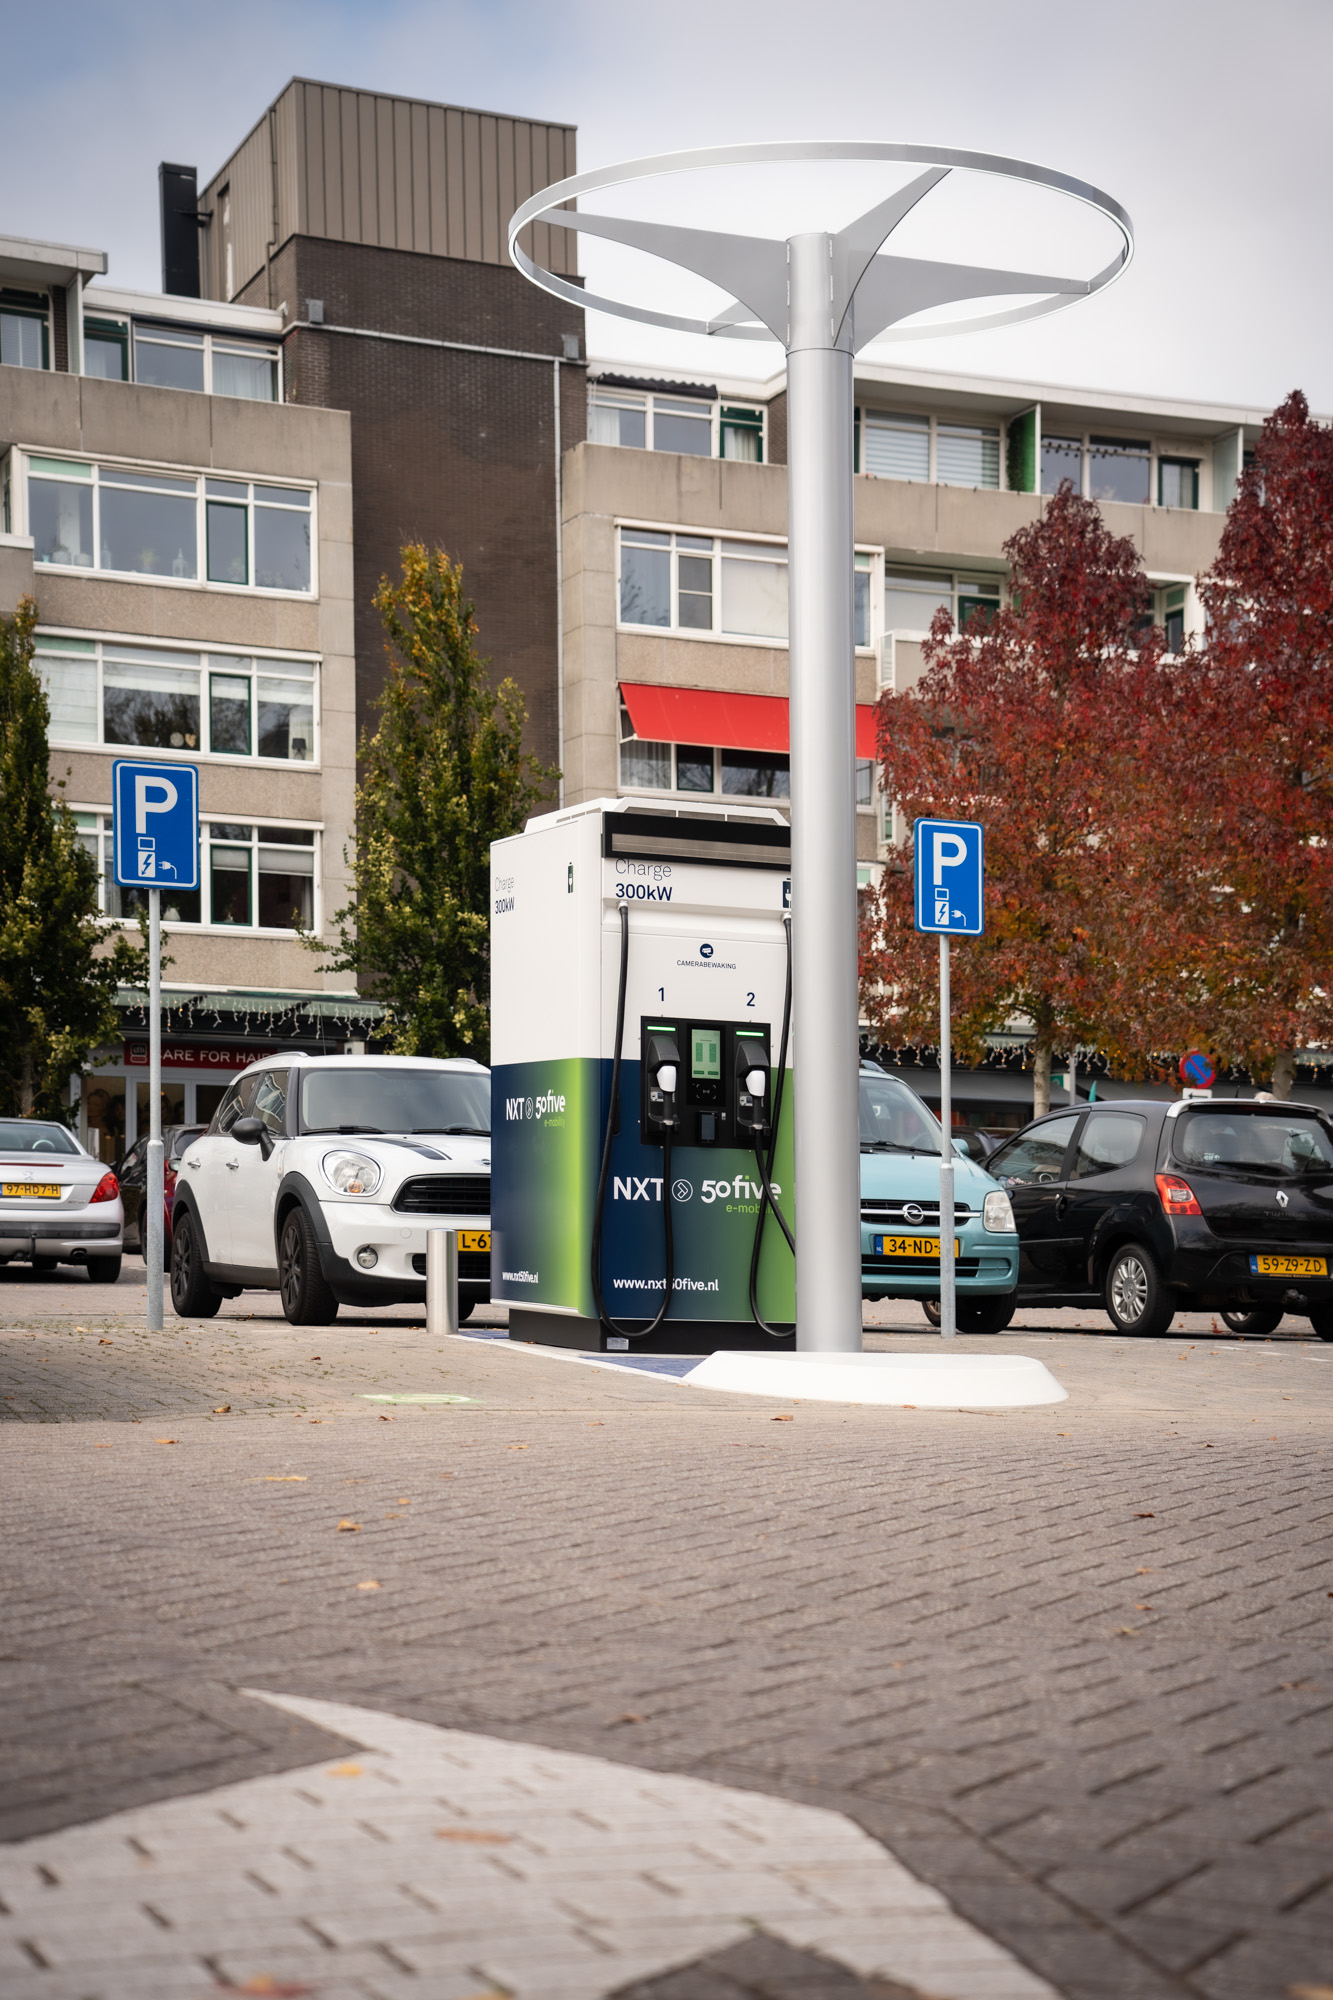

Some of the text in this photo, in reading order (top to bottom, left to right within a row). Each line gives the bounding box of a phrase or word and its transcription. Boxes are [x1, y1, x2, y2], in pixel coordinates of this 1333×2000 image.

[135, 775, 178, 834] P
[933, 832, 967, 886] P
[615, 858, 672, 882] Charge
[494, 877, 515, 893] Charge
[615, 882, 673, 902] 300kW
[494, 896, 515, 914] 300kW
[676, 960, 737, 970] CAMERABEWAKING
[658, 987, 665, 1002] 1
[746, 992, 756, 1007] 2
[160, 1049, 195, 1062] ARE
[200, 1050, 231, 1063] FOR
[505, 1097, 525, 1121] NXT
[613, 1176, 664, 1202] NXT
[462, 1233, 491, 1249] L-6
[889, 1239, 941, 1254] 34-ND-
